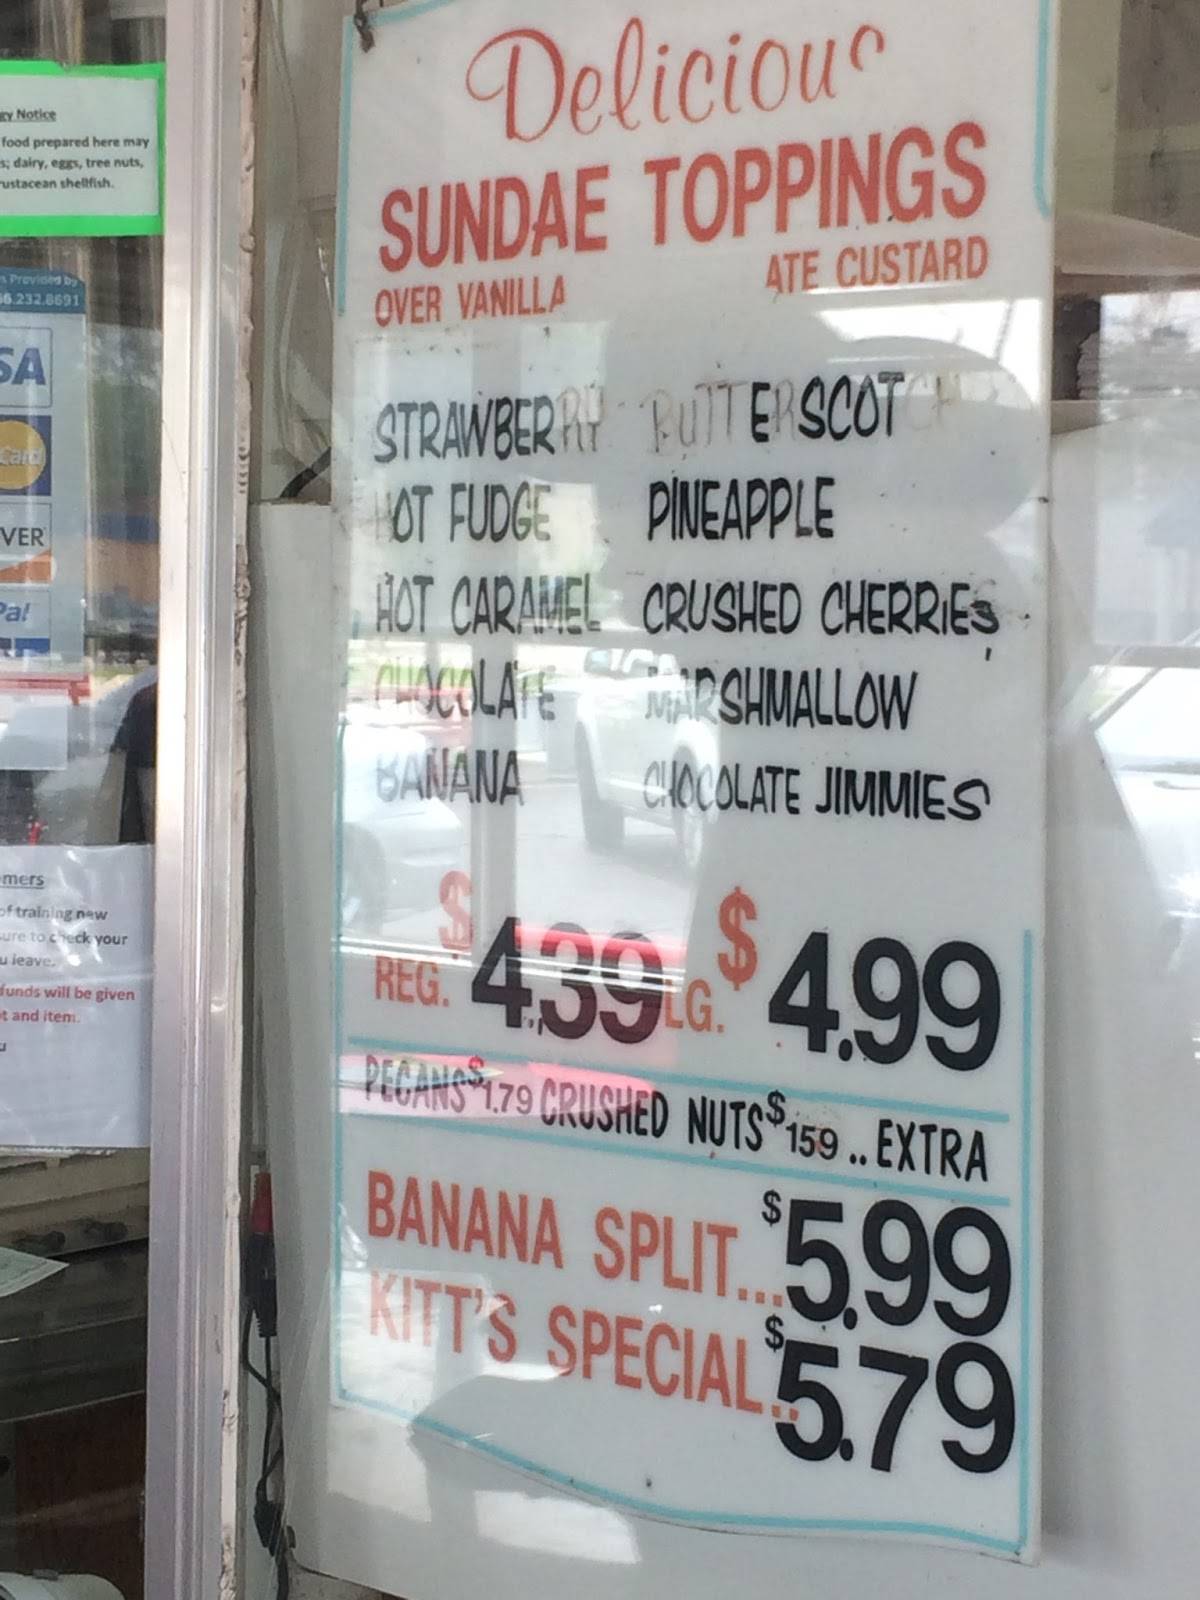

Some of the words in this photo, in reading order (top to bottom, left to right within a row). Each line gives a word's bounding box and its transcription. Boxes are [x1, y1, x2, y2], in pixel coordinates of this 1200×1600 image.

[2, 136, 30, 148] food
[33, 136, 90, 150] prepared
[93, 136, 120, 148] here
[123, 138, 150, 149] may
[16, 108, 57, 121] Notice
[13, 157, 49, 170] dairy,
[51, 159, 83, 170] eggs,
[86, 158, 111, 168] tree
[114, 158, 144, 169] nuts,
[60, 177, 115, 189] shellfish.
[379, 165, 610, 273] SUNDAE
[644, 121, 988, 246] TOPPINGS
[374, 287, 442, 327] OVER
[457, 275, 567, 320] VANILLA
[766, 249, 820, 294] ATE
[836, 235, 990, 289] CUSTARD
[449, 480, 551, 543] FUDGE
[648, 476, 835, 541] PINEAPPLE
[376, 572, 434, 633] HOT
[451, 572, 602, 635] CARAMEL
[643, 579, 801, 635] CRUSHED
[821, 579, 1000, 636] CHERRIES
[374, 656, 556, 721] CHOCOLATE
[644, 666, 919, 730] MARSHMALLOW
[376, 746, 524, 806] BANANA
[643, 760, 801, 816] CHOCOLATE
[815, 766, 991, 821] JIMMIES
[16, 906, 73, 921] training
[76, 910, 108, 920] new
[30, 930, 46, 942] to
[96, 934, 128, 946] your
[12, 1009, 39, 1022] and
[44, 985, 70, 999] will
[74, 986, 92, 1000] be
[95, 987, 136, 1003] given
[374, 955, 450, 1007] REG.
[664, 978, 725, 1033] LG.
[366, 1054, 467, 1113] PECANS
[540, 1077, 669, 1139] CRUSHED
[688, 1096, 763, 1152] NUTS
[367, 1171, 564, 1269] BANANA
[370, 1270, 517, 1363] KITT'S
